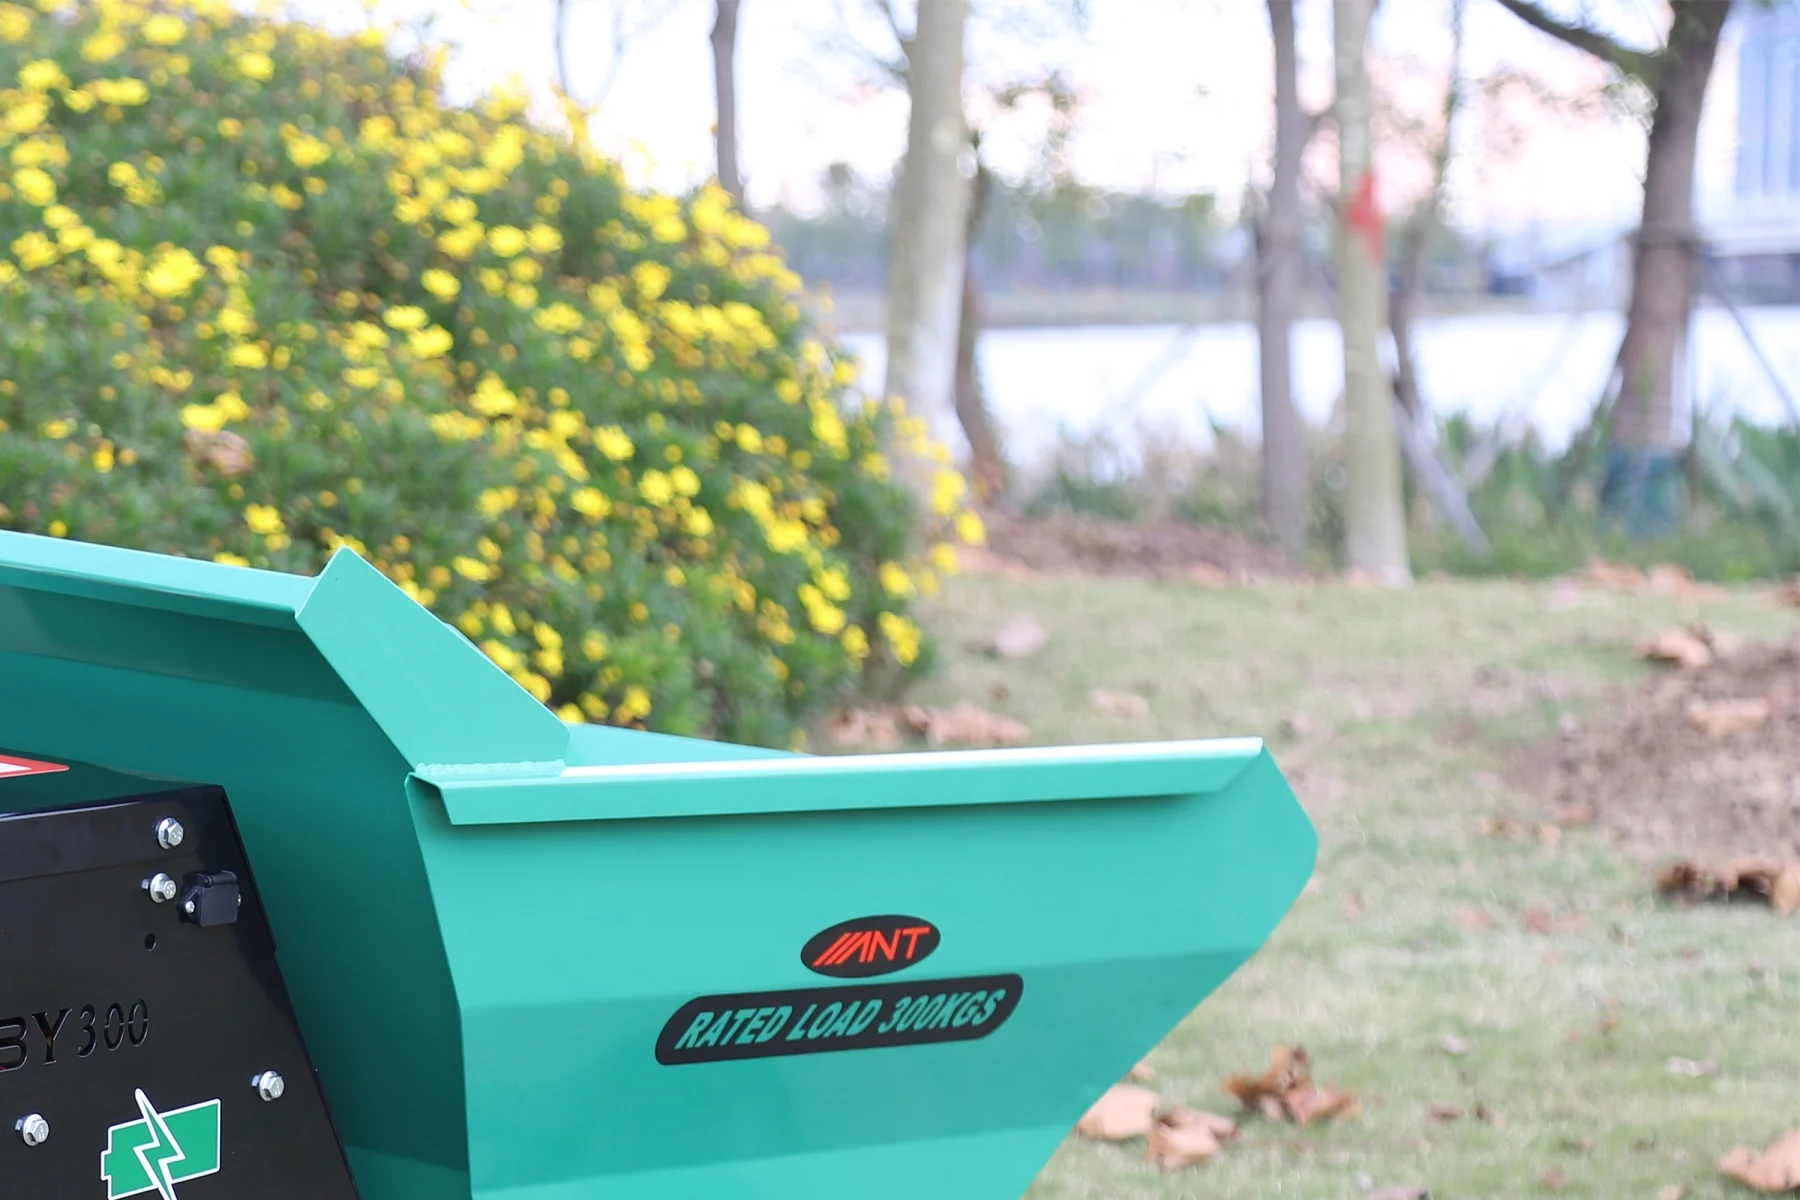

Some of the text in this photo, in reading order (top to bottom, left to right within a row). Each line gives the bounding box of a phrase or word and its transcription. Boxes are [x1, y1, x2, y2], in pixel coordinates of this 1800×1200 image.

[813, 926, 932, 967] ANT
[674, 988, 1007, 1050] RATED LOAD 300KGS
